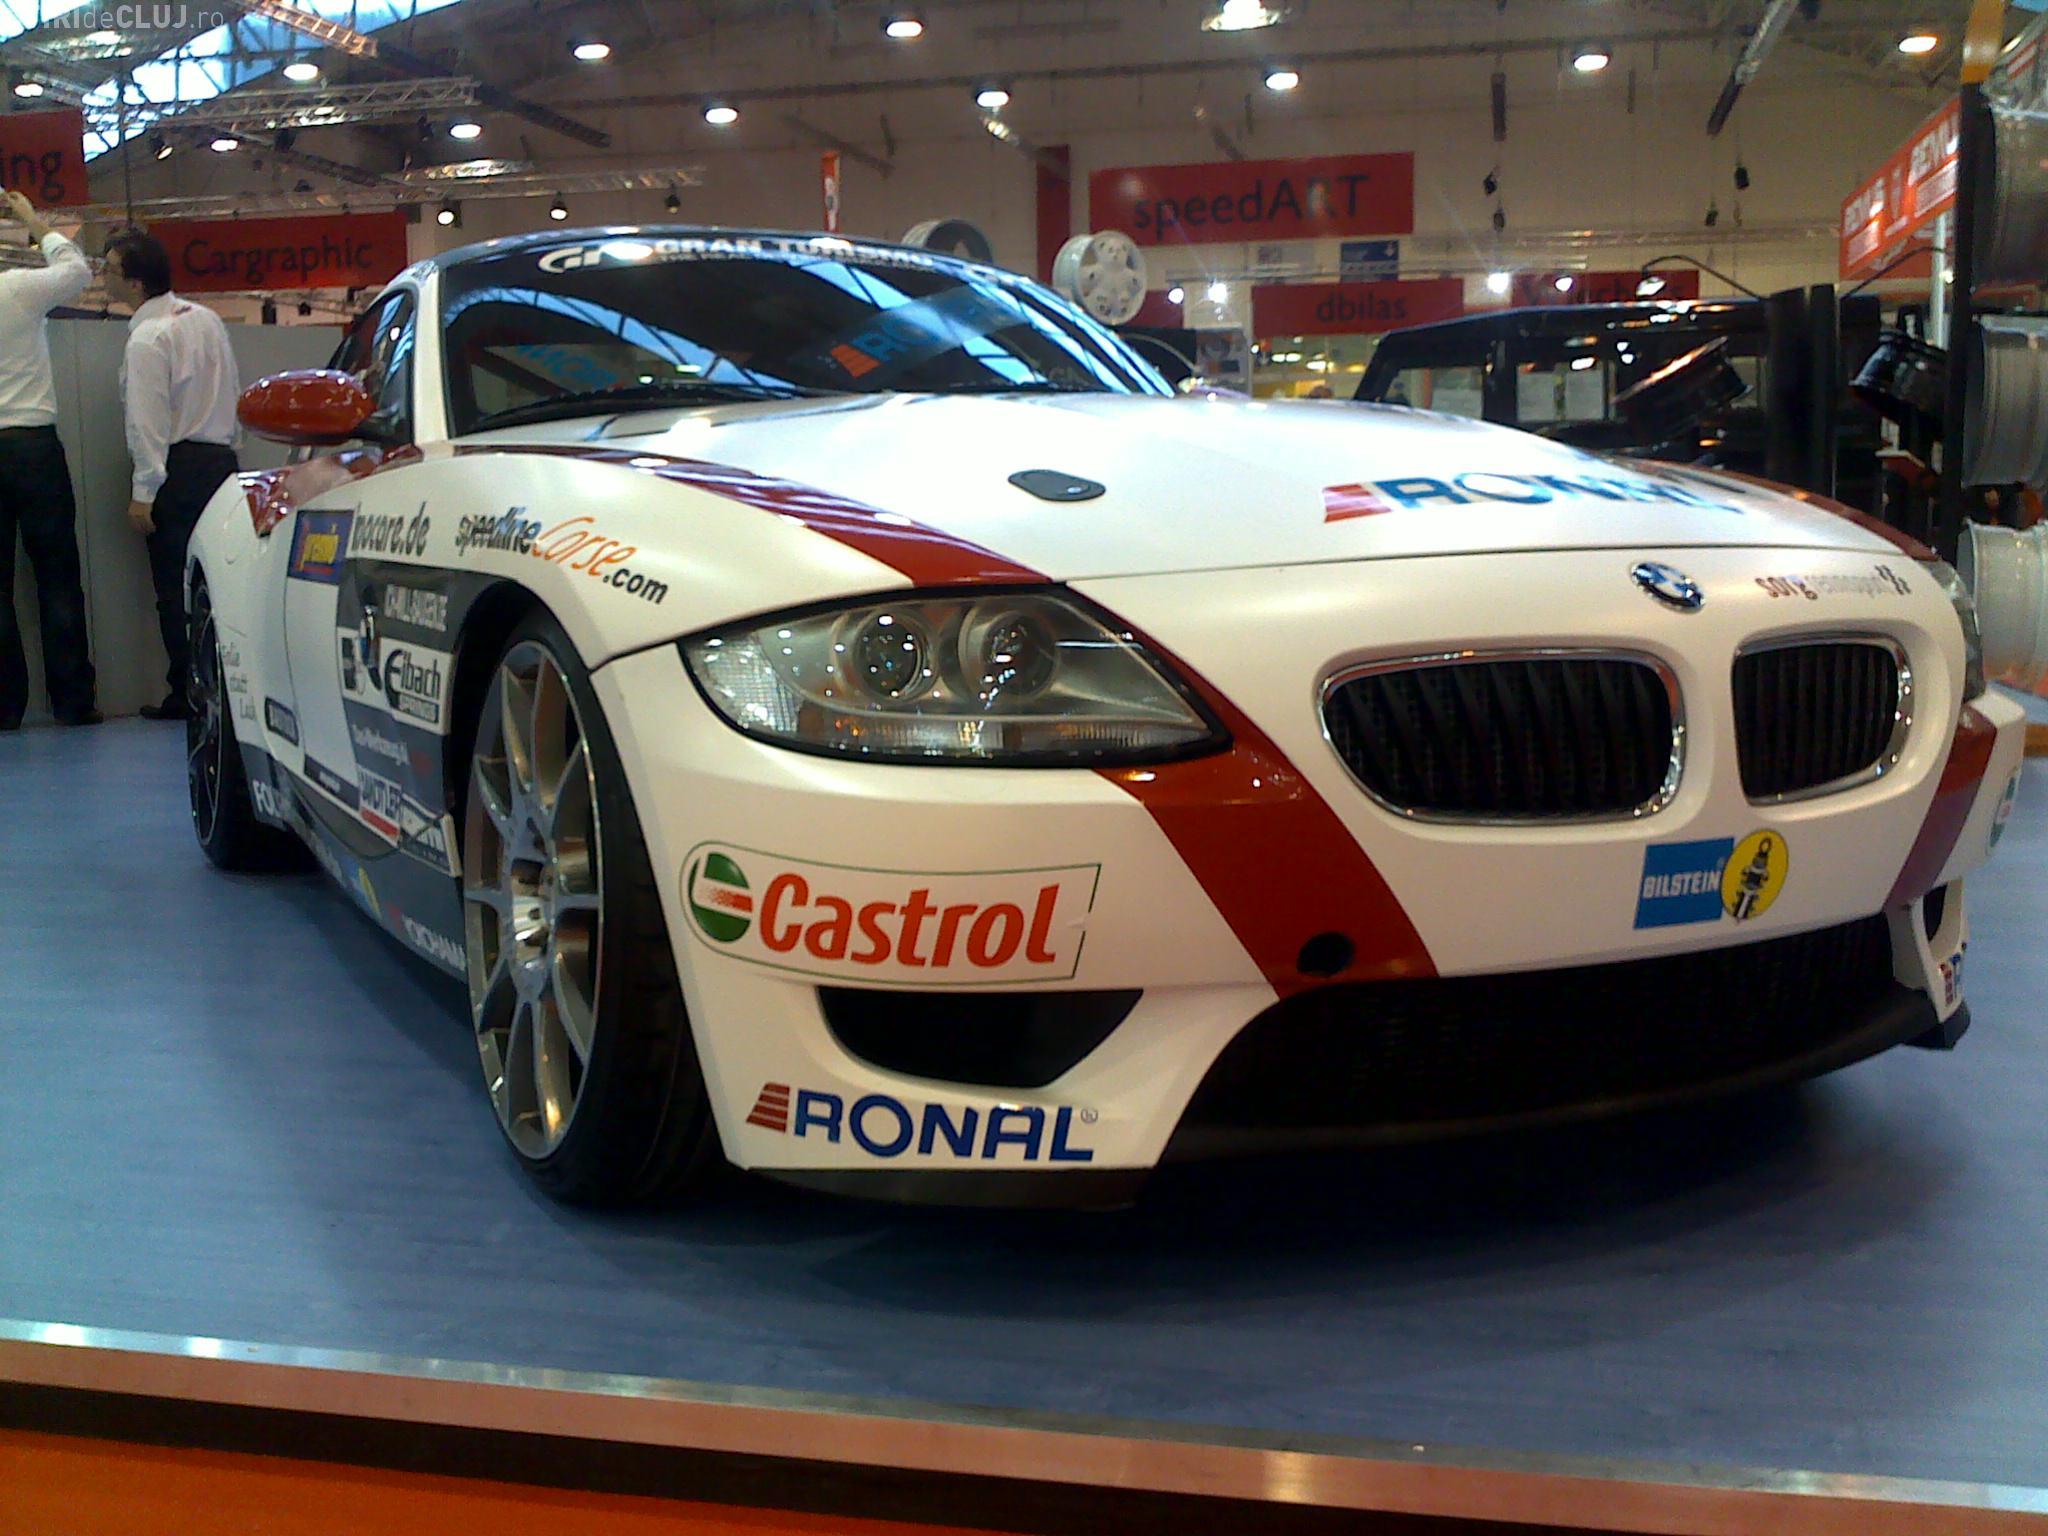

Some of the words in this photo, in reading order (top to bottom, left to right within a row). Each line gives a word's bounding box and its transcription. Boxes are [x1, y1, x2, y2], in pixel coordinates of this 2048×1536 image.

[1133, 173, 1369, 241] speedART
[183, 235, 373, 285] Cargraphic
[1315, 291, 1407, 323] dbilas
[384, 649, 441, 709] Eibach
[1642, 870, 1722, 899] BILSTEIN
[759, 872, 1060, 968] Castrol
